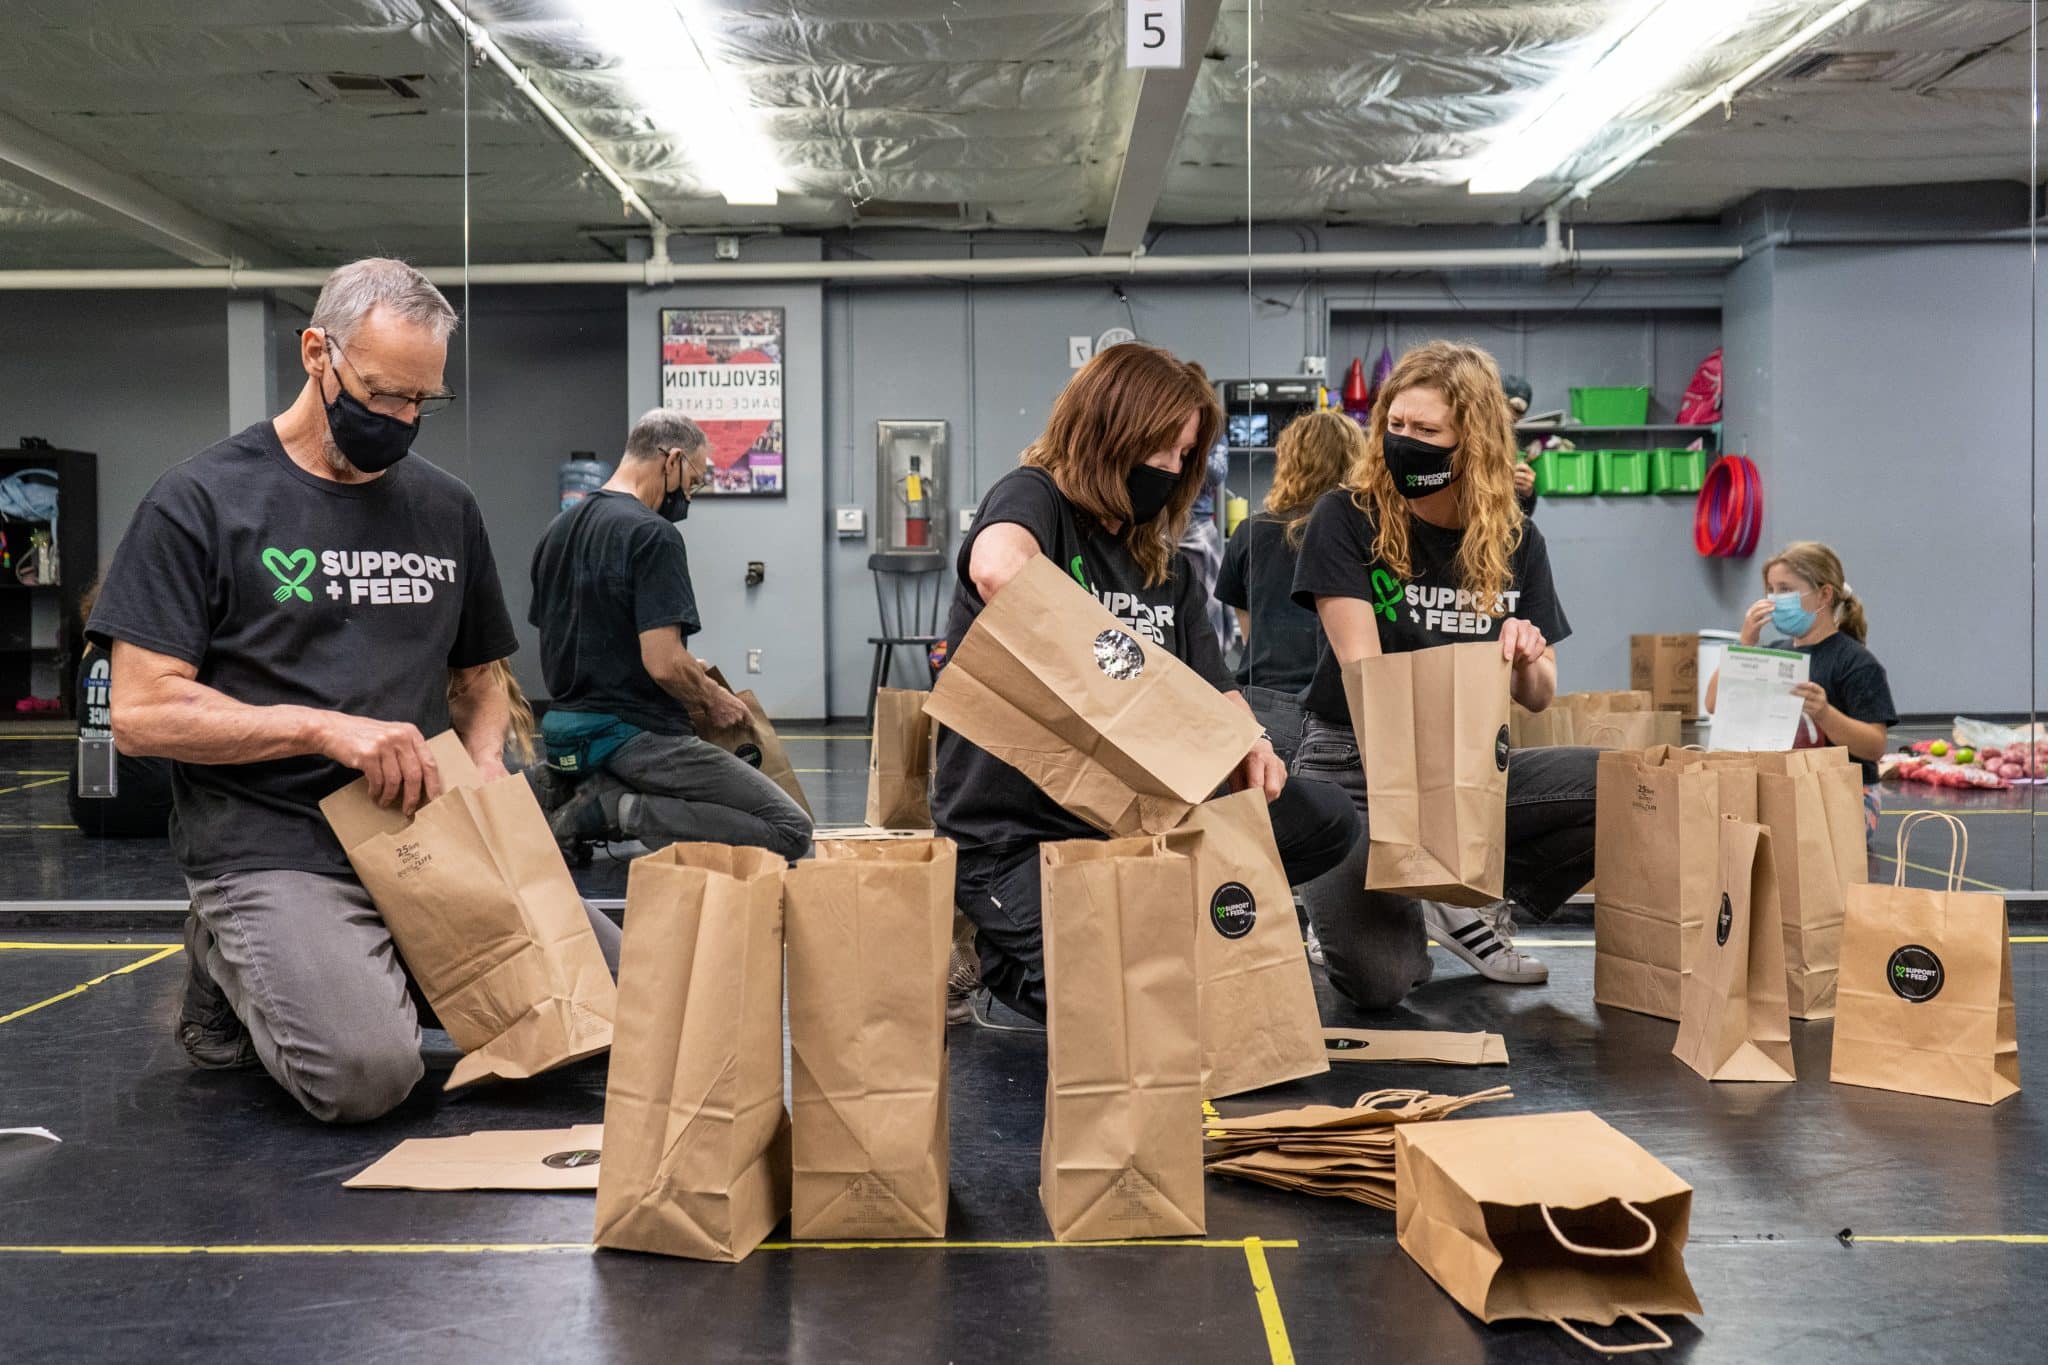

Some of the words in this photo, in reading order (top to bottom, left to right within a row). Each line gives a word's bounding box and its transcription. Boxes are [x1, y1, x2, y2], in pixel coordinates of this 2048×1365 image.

[1143, 12, 1166, 49] 5
[1417, 471, 1452, 482] SUPPORT
[1423, 478, 1445, 487] FEED
[321, 550, 457, 583] SUPPORT
[325, 580, 344, 601] +
[349, 577, 434, 605] FEED
[1425, 609, 1493, 635] FEED
[1225, 902, 1249, 912] SUPPORT
[1230, 909, 1245, 917] FEED
[1905, 967, 1937, 977] SUPPORT
[1910, 973, 1929, 981] FEED
